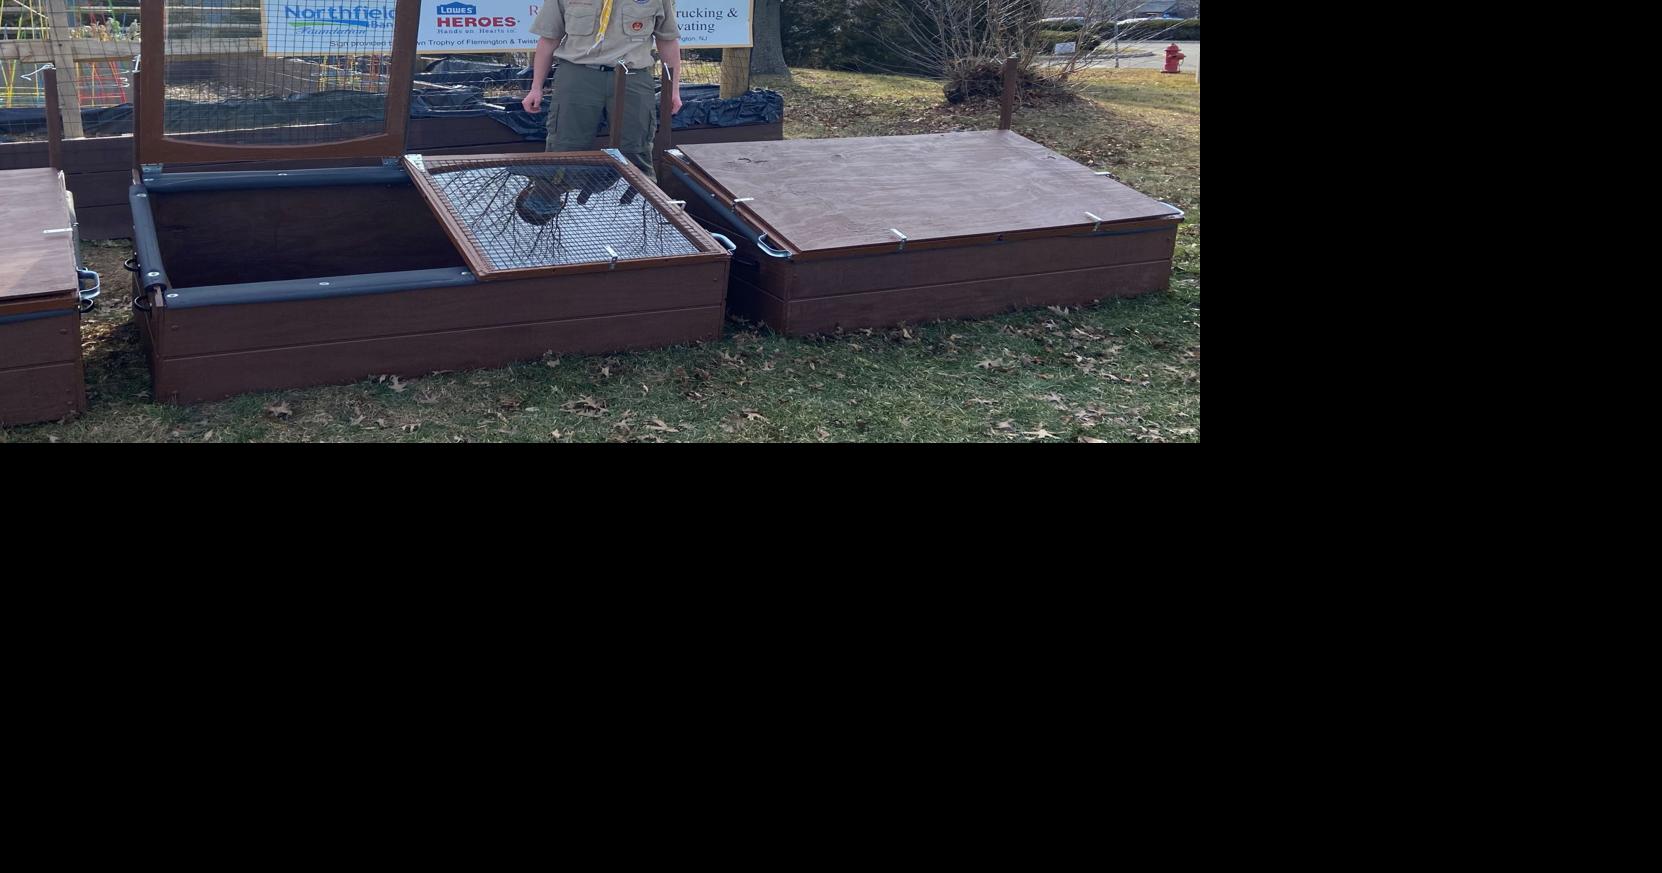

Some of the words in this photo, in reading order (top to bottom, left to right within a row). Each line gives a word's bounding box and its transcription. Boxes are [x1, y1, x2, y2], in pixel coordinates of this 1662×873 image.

[676, 7, 723, 20] rucking
[727, 7, 738, 18] &
[371, 20, 393, 28] Ban
[437, 16, 517, 27] HEROES
[677, 20, 715, 33] vating
[295, 25, 368, 35] Foundation
[329, 40, 349, 48] Sign
[351, 39, 386, 48] provided
[466, 38, 508, 46] Flemington
